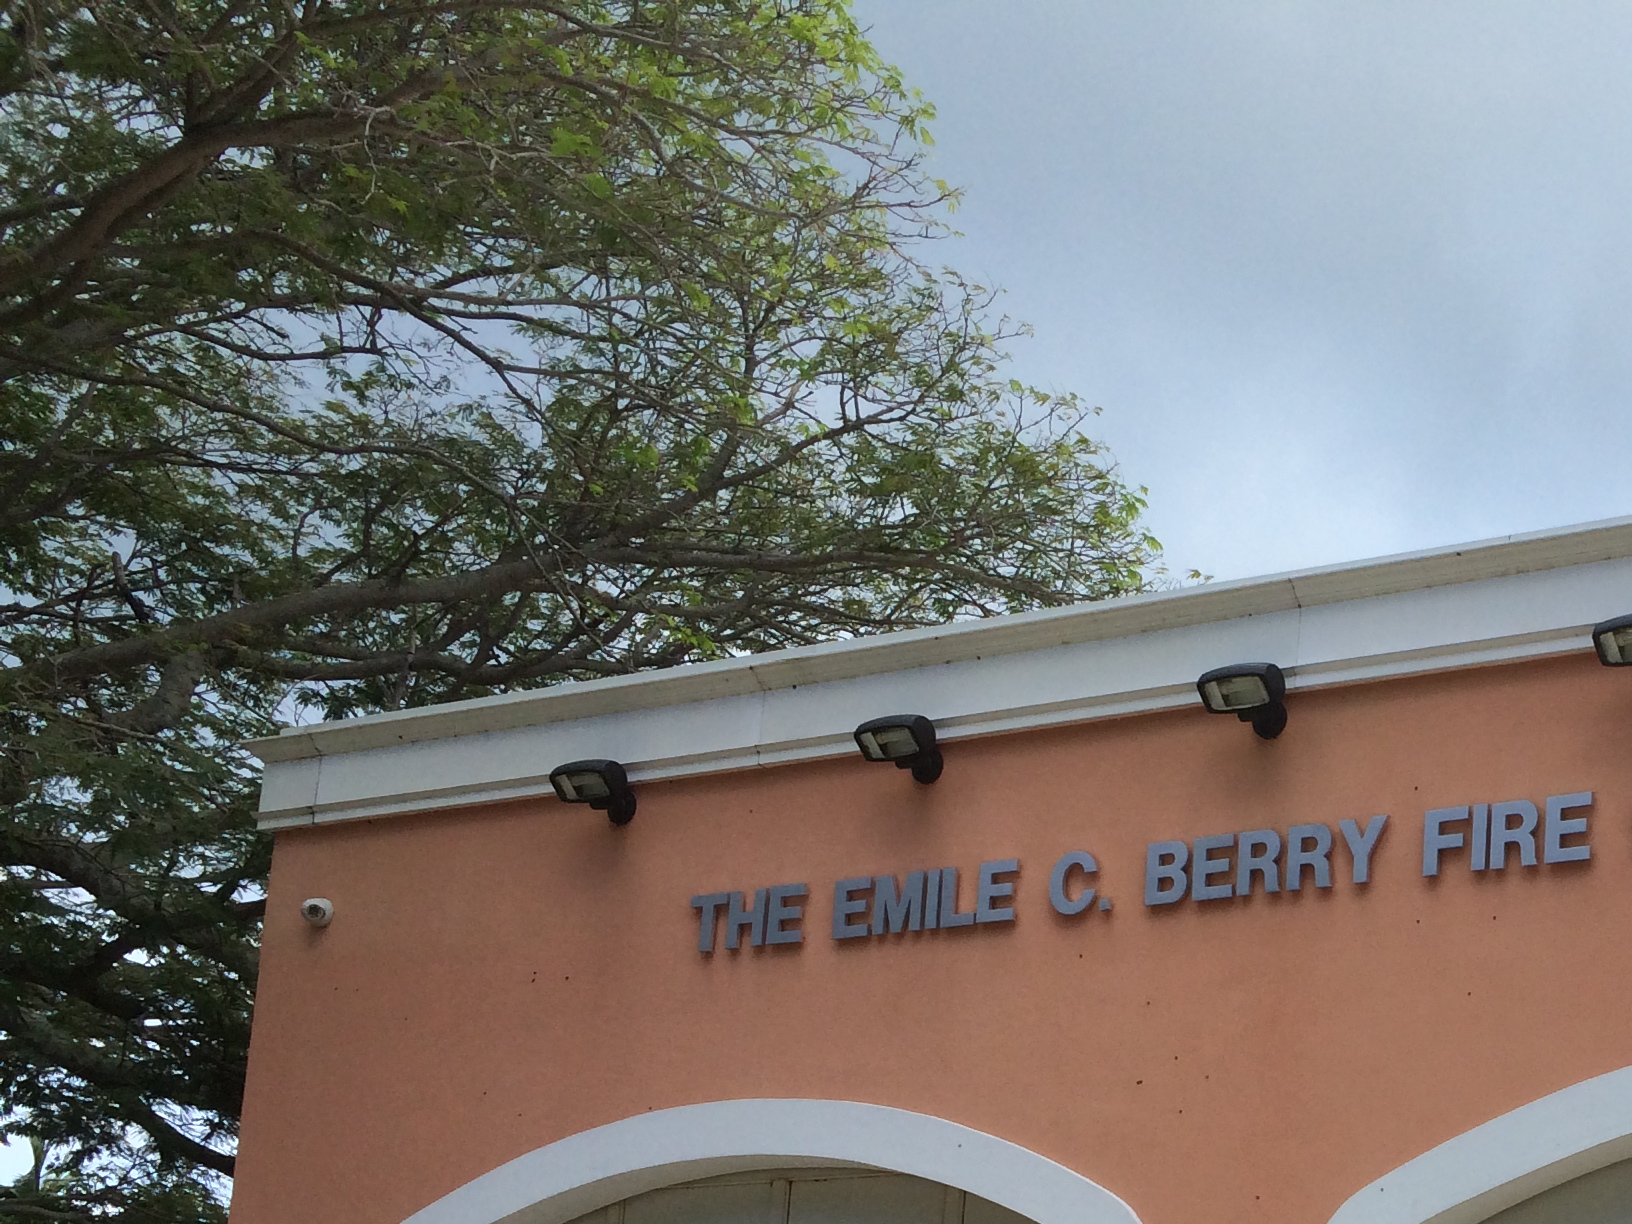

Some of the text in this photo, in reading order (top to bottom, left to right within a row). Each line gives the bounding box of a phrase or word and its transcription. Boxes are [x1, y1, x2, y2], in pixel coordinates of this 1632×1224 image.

[690, 883, 807, 951] THE
[831, 858, 1020, 941] EMILE
[1050, 851, 1112, 916] C.
[1145, 814, 1390, 906] BERRY
[1422, 791, 1595, 877] FIRE
